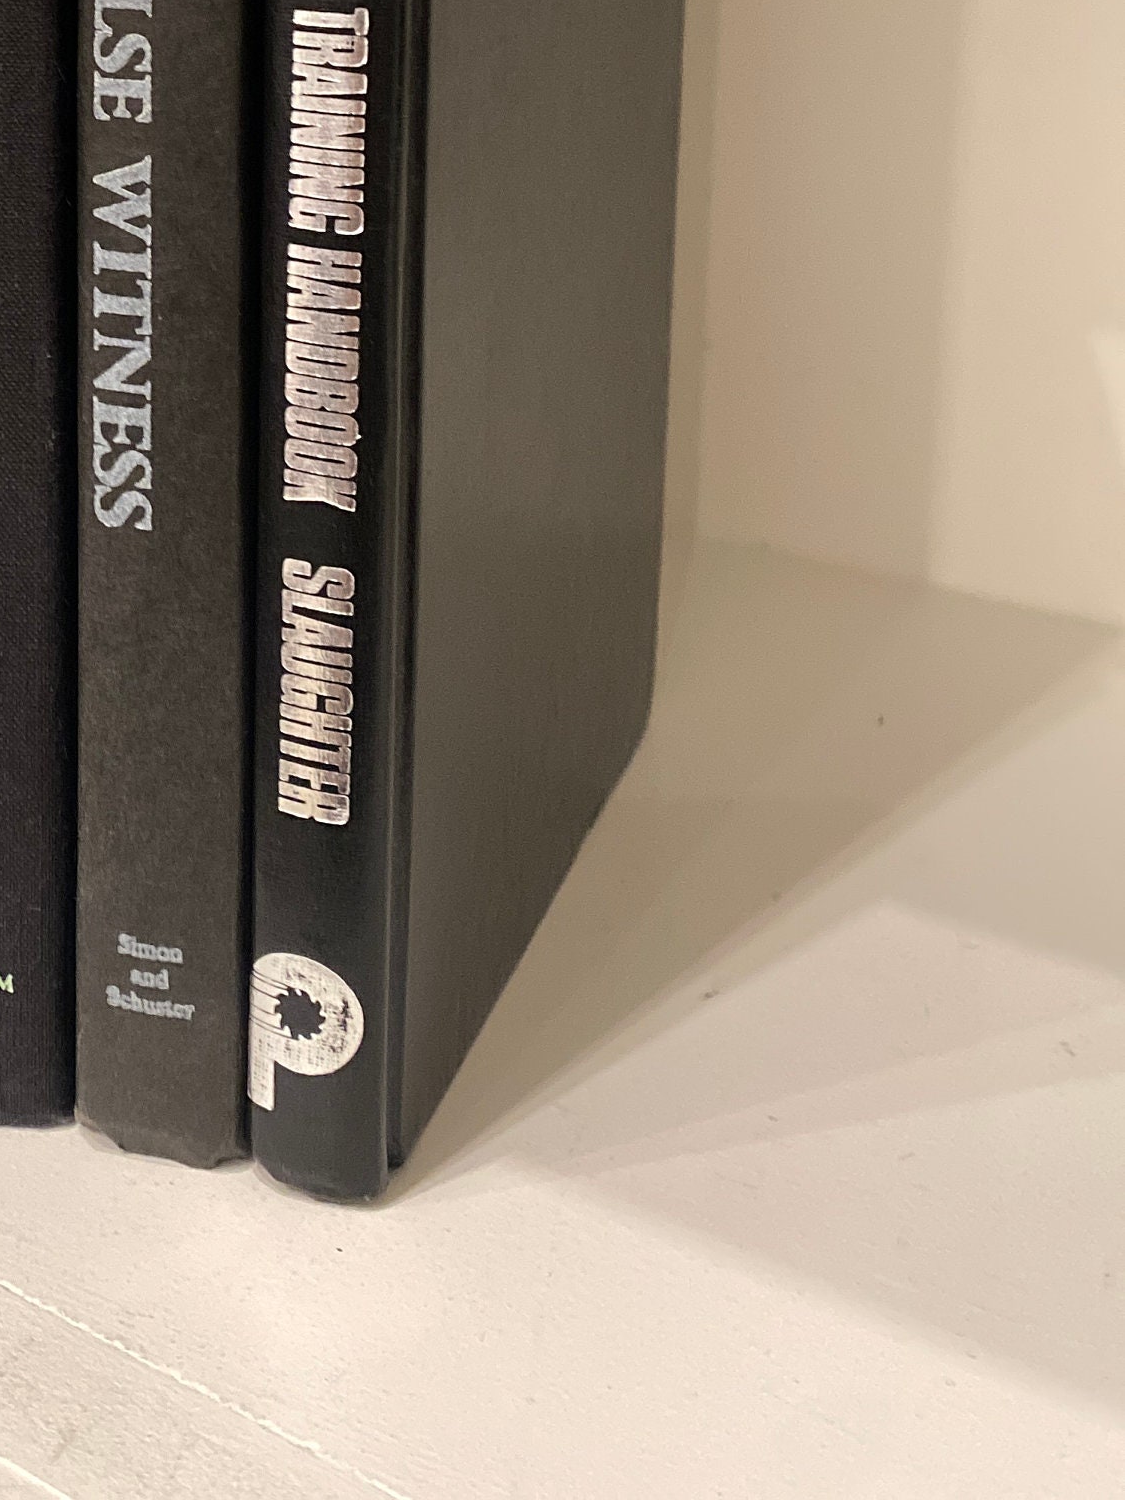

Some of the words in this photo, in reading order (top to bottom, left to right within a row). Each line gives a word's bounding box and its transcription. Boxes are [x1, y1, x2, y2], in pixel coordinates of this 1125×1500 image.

[287, 7, 370, 234] TRAINING
[92, 154, 153, 531] WITNESS
[282, 242, 363, 513] HANDBOOK
[277, 557, 356, 826] SLAUGHTER
[117, 933, 183, 963] Simon
[130, 968, 169, 989] and
